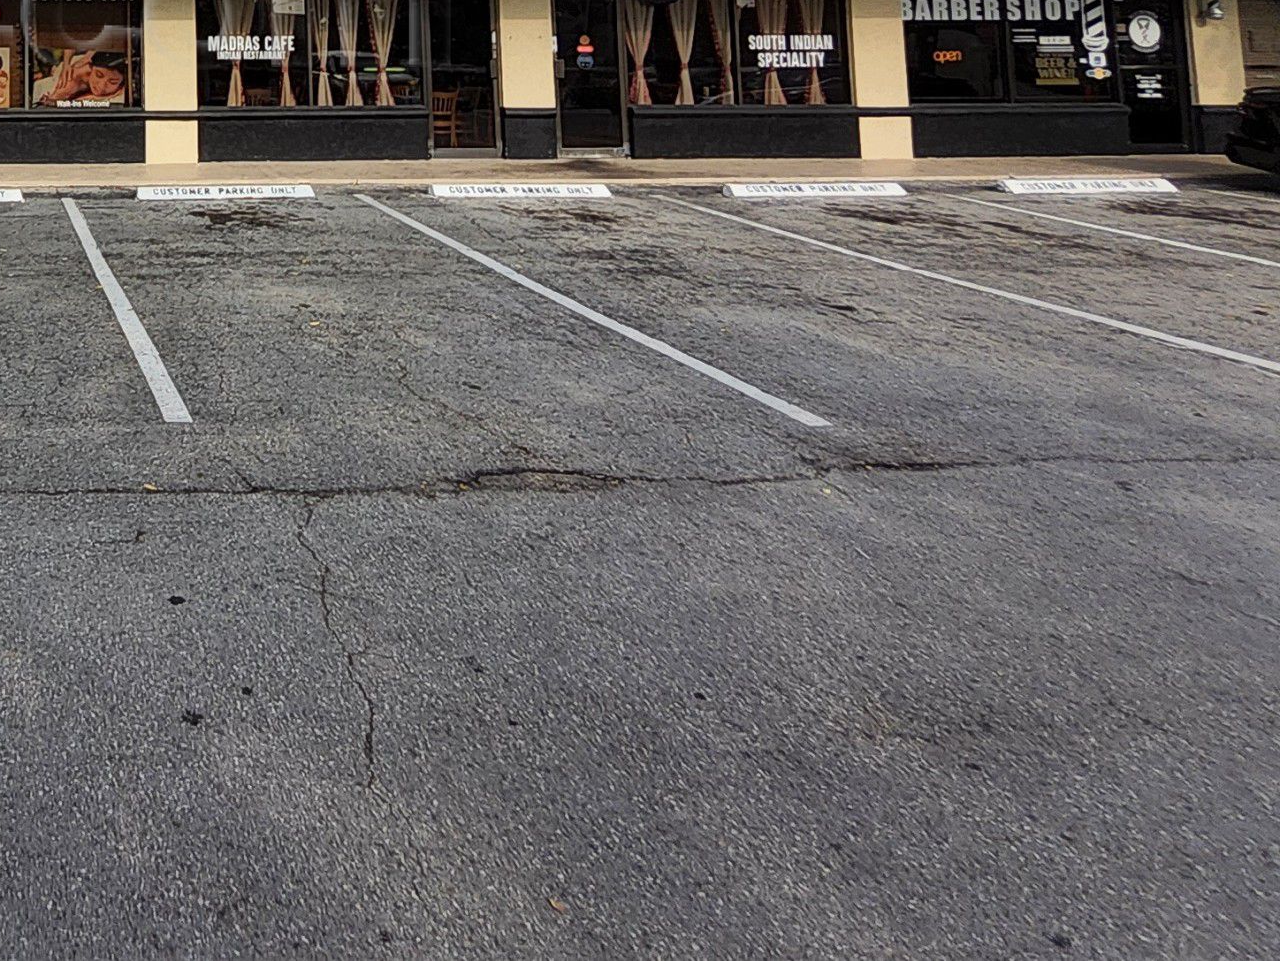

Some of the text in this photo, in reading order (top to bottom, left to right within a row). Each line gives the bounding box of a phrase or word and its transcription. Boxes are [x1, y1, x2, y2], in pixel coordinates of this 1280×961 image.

[208, 36, 295, 51] MADRAS CAFE
[748, 34, 834, 50] SOUTH INDIAN
[217, 50, 286, 60] INDIAN RESTAURANT
[757, 51, 825, 67] SPECIALITY
[933, 50, 962, 64] open
[153, 188, 211, 196] CUSTOMER
[218, 187, 264, 195] PARKING
[448, 185, 508, 194] CUSTOMER
[513, 186, 561, 194] PARKING
[745, 184, 804, 194] CUSTOMER
